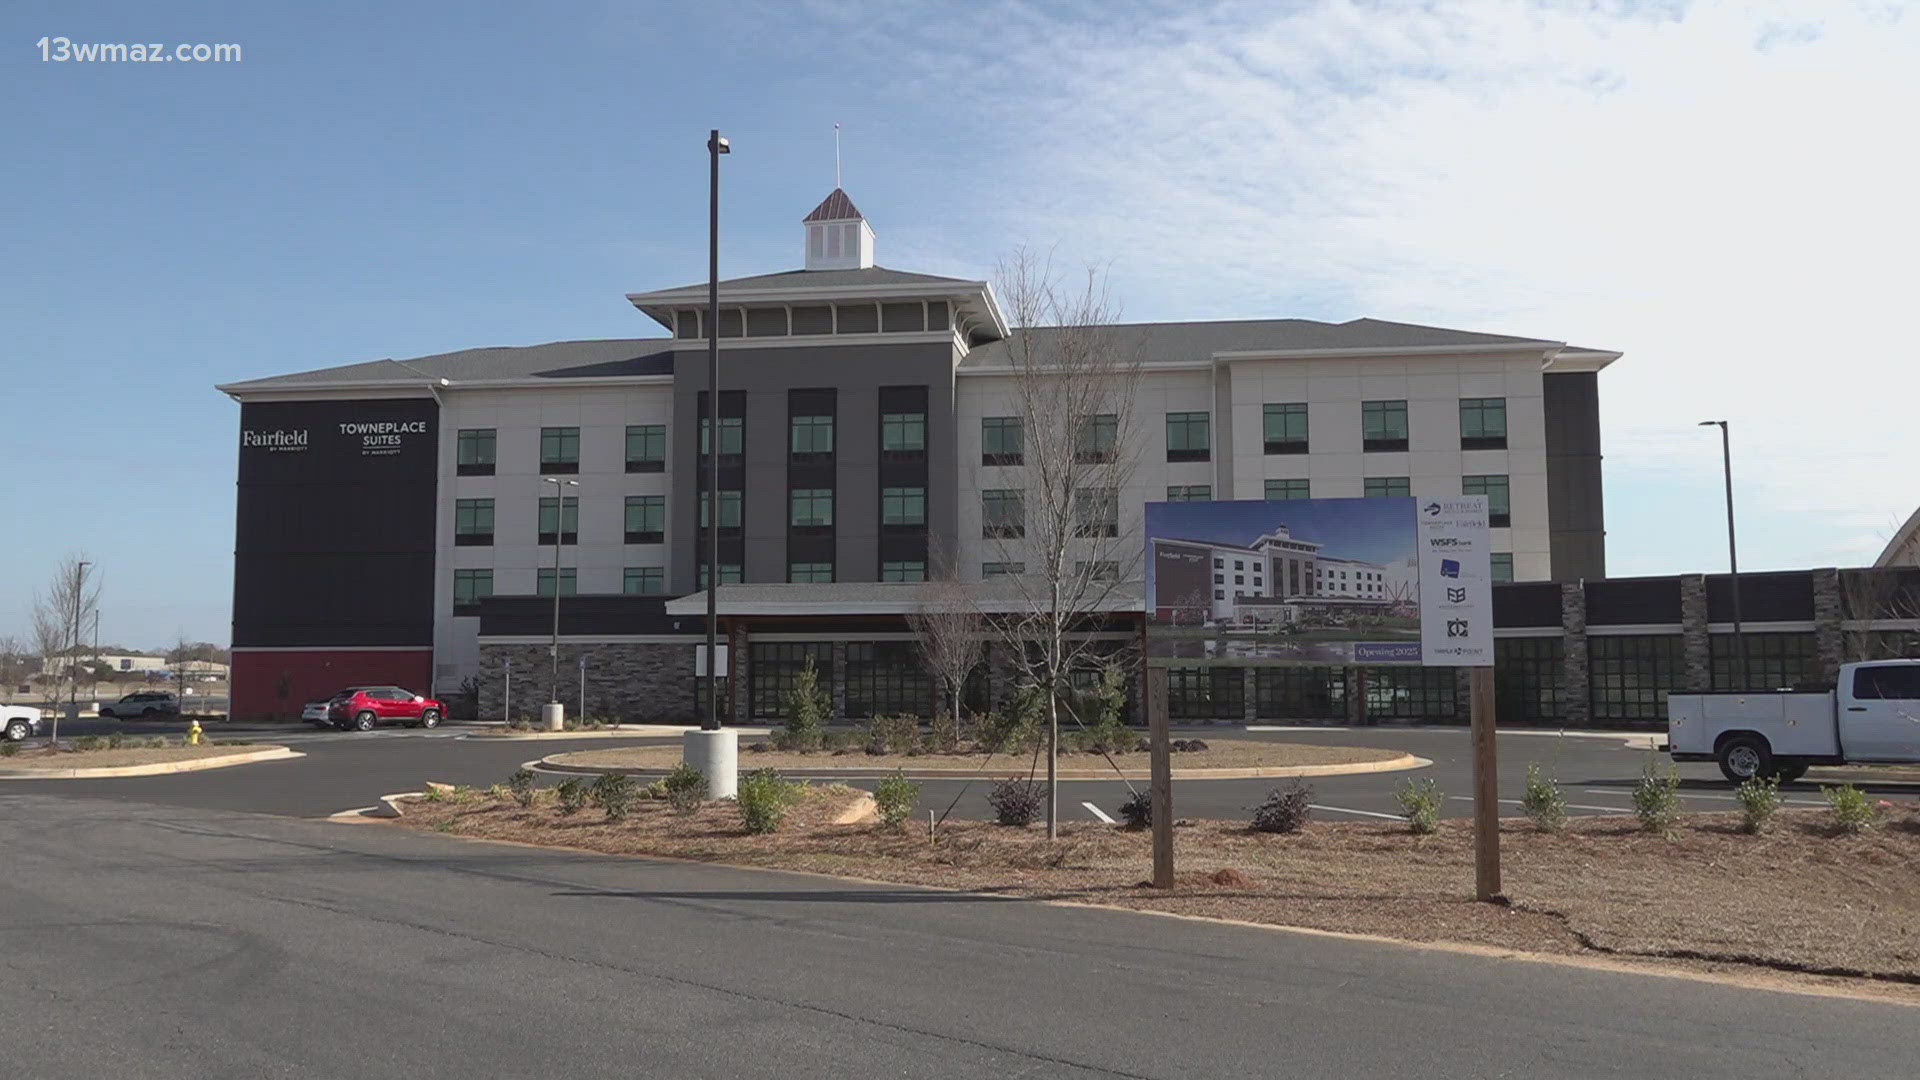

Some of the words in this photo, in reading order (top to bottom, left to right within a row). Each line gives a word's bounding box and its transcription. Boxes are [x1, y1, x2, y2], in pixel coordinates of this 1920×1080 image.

[339, 421, 426, 435] TOWNEPLACE
[243, 429, 308, 447] Fairfield
[362, 434, 402, 446] SUITES
[1430, 538, 1458, 546] WSFS
[1358, 647, 1395, 658] Opening
